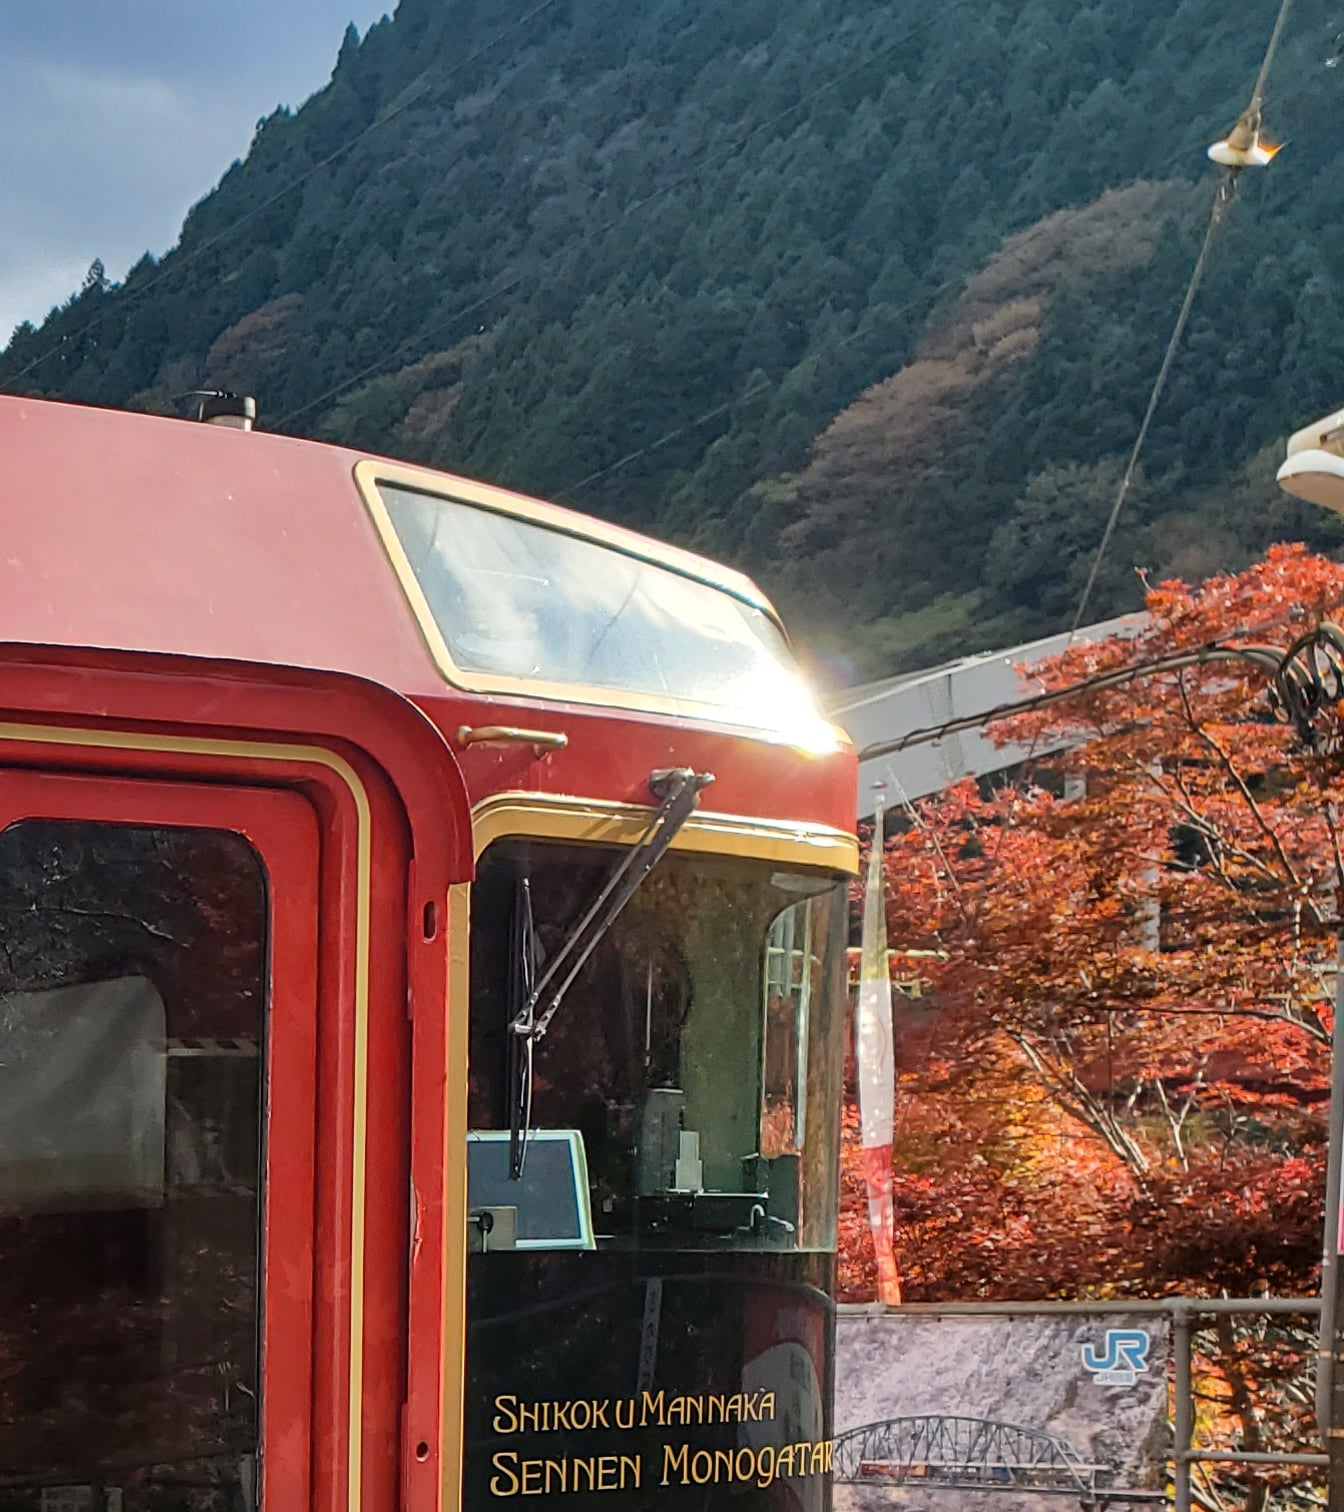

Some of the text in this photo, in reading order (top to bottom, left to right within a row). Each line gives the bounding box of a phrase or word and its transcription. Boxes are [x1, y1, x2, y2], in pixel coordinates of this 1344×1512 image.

[1082, 1330, 1149, 1371] JR
[492, 1390, 776, 1434] SHIKOKU MANNAKA
[490, 1452, 642, 1497] SENNEN
